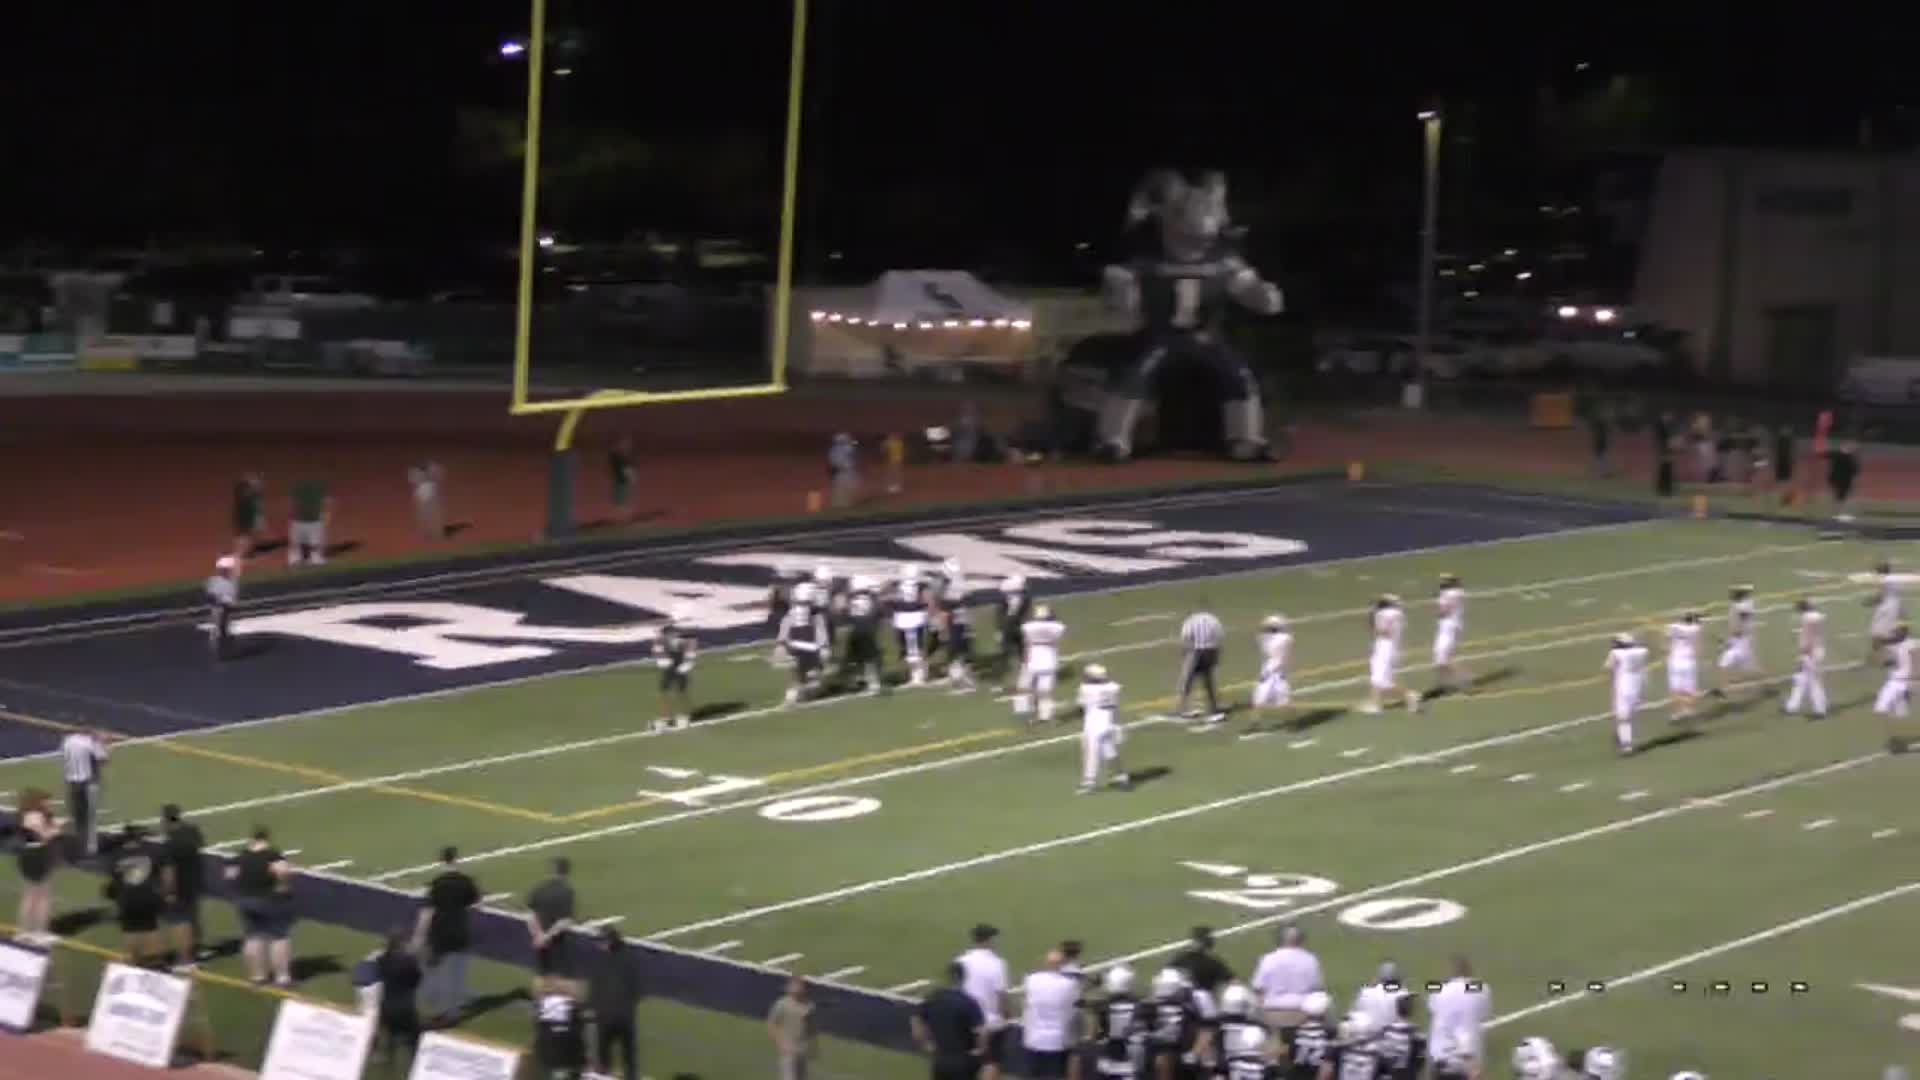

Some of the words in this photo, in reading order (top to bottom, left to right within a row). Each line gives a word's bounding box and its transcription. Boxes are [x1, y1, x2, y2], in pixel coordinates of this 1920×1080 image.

[198, 519, 1308, 669] RAMS
[636, 765, 882, 821] 10
[1175, 860, 1467, 929] 20
